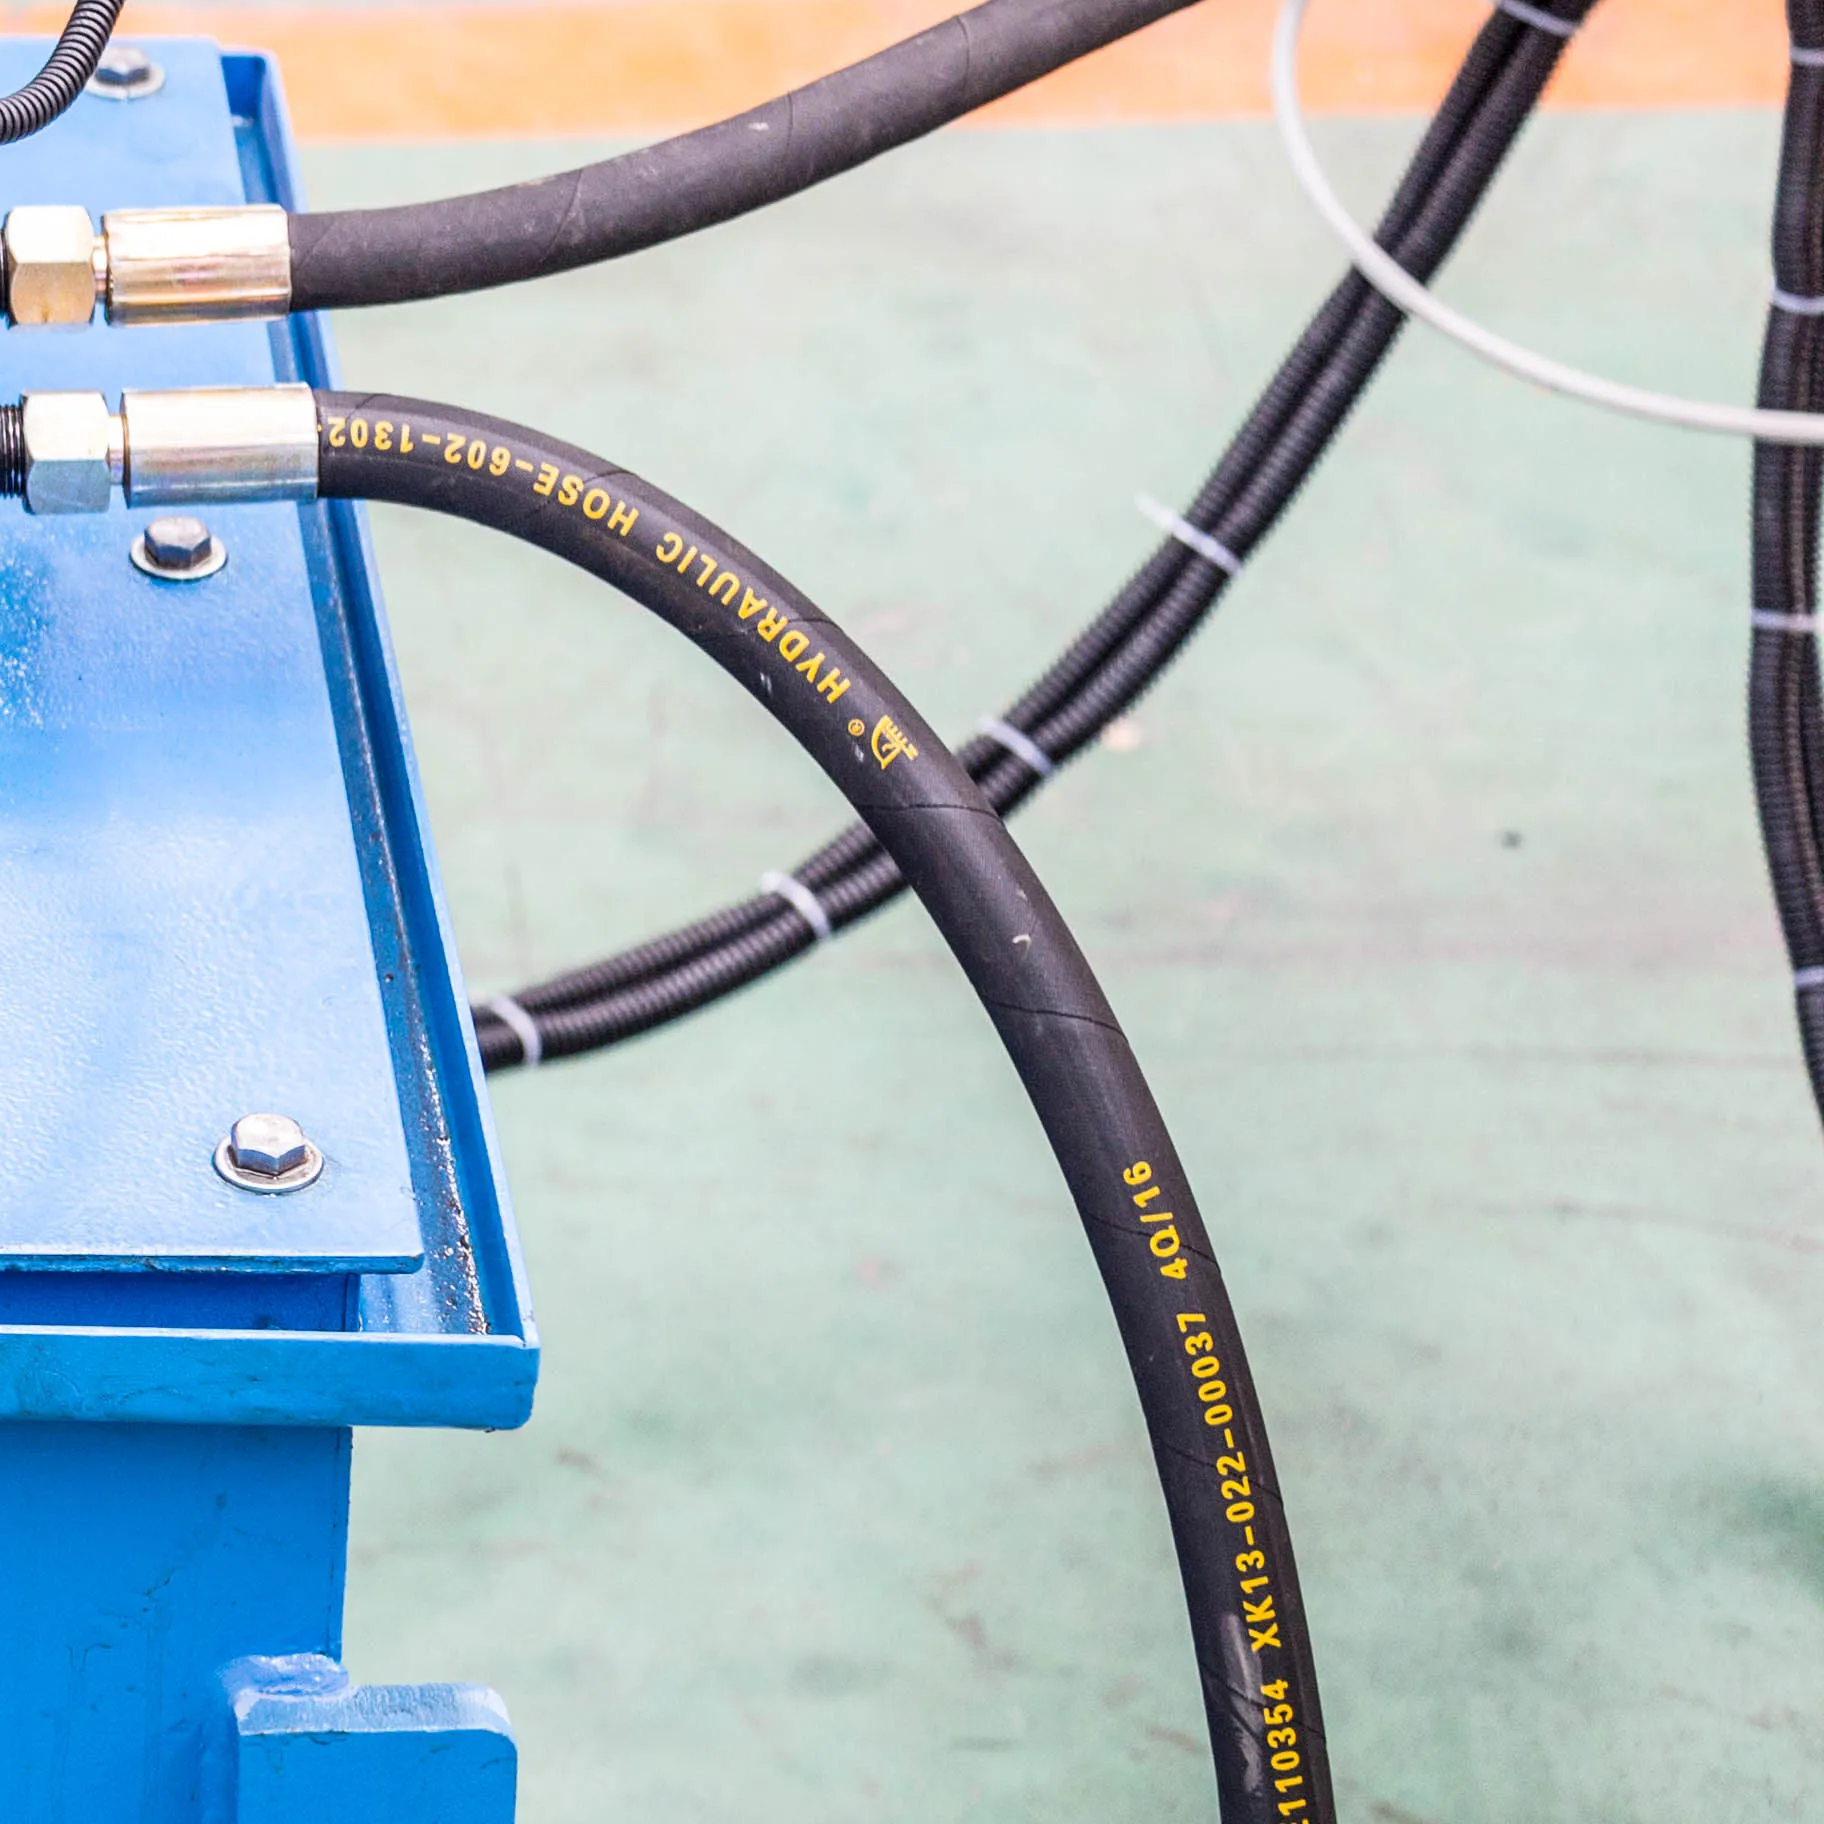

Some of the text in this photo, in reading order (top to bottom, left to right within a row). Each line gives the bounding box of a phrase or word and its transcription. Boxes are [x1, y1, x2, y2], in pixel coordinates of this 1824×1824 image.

[318, 416, 851, 706] HYDRAULIC HOSE-602-1302
[1122, 1160, 1189, 1280] 4Q/16
[1175, 1313, 1282, 1652] XK13-022-00037
